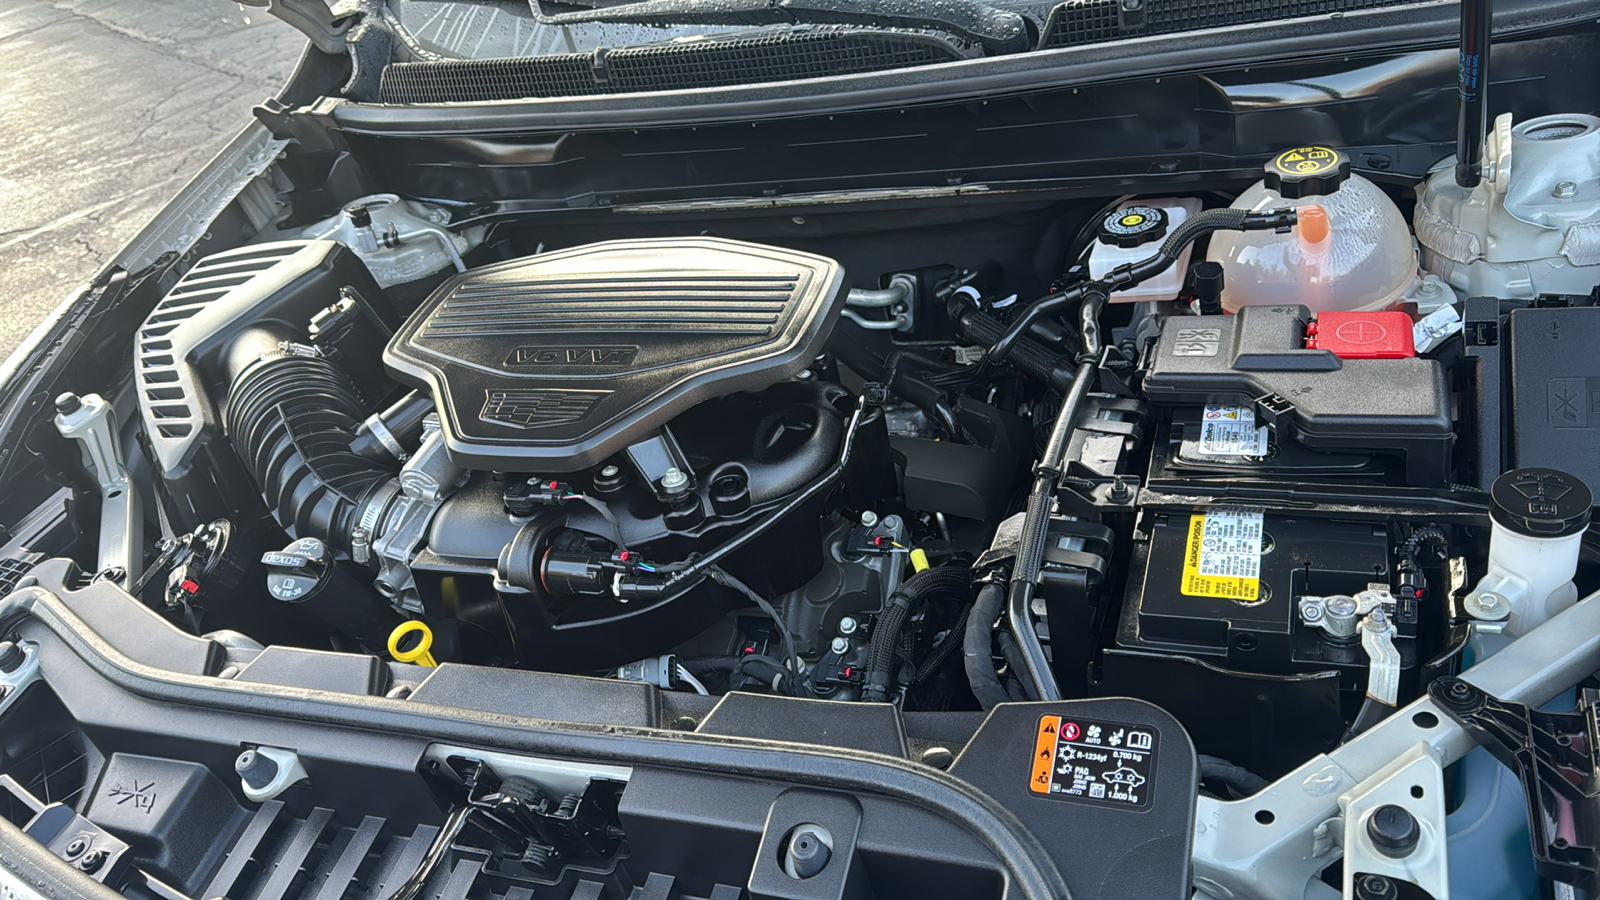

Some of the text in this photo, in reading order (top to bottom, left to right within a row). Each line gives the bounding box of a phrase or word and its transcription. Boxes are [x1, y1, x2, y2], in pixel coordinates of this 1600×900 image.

[516, 349, 560, 363] V6
[1203, 422, 1215, 450] ACDelco
[265, 553, 303, 566] dexos
[282, 587, 302, 597] 5W-30
[1077, 751, 1107, 763] R-1234yf
[1113, 751, 1142, 762] 0.700 kg
[1074, 766, 1089, 775] PAG
[1108, 791, 1138, 803] 1.000 kg
